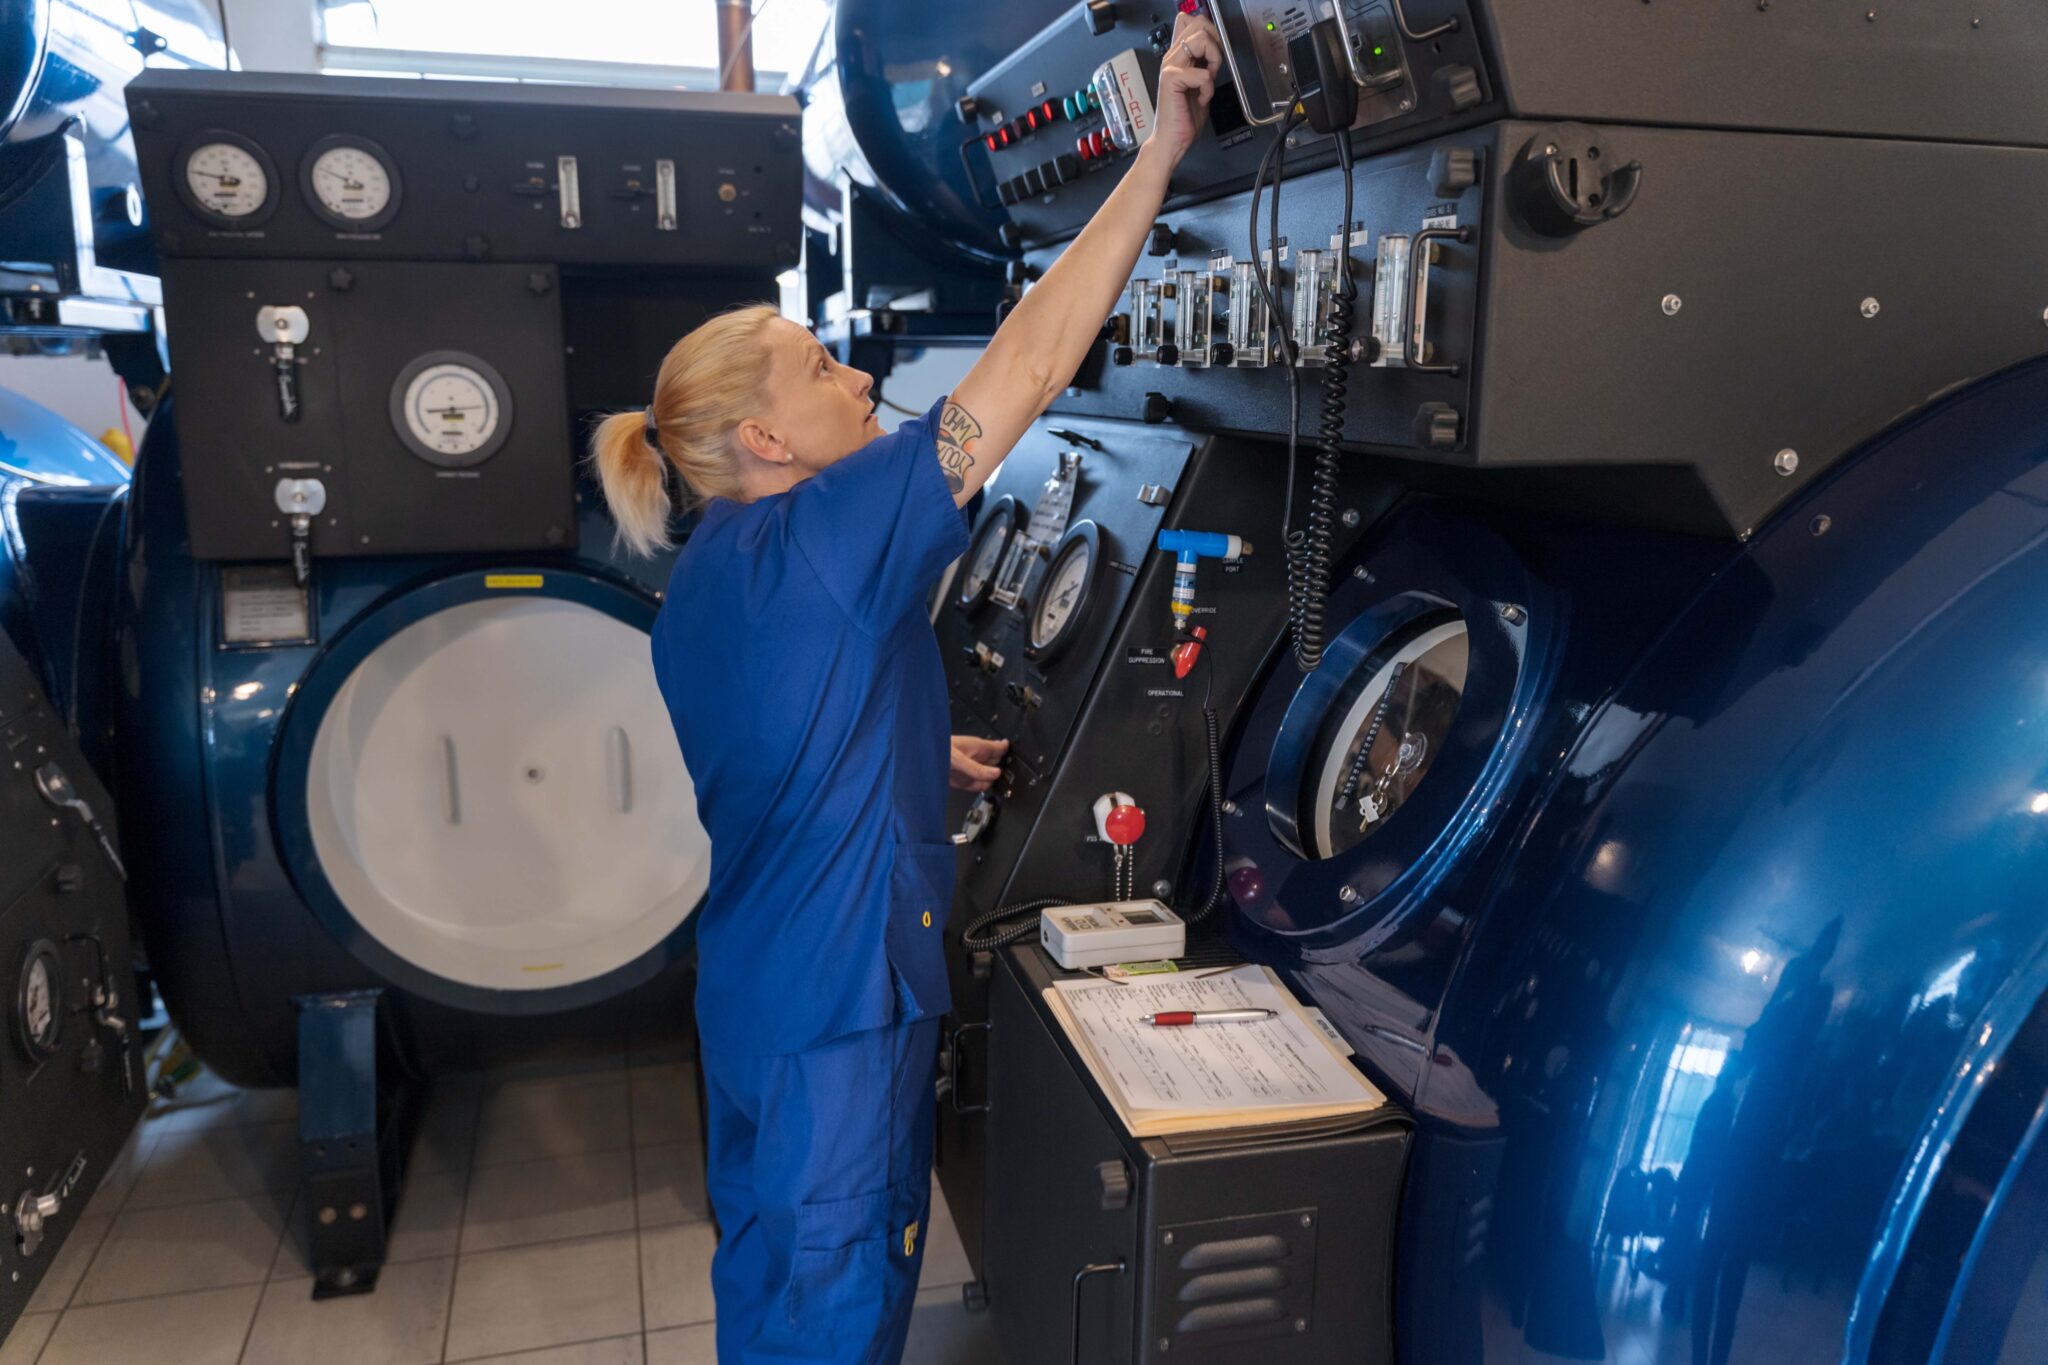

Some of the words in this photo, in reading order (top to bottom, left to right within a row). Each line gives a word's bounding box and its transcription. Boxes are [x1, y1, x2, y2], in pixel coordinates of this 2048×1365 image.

[1120, 72, 1146, 129] FIRE
[1128, 656, 1165, 664] SUPPRESSION
[1147, 689, 1184, 697] OPERATIONAL
